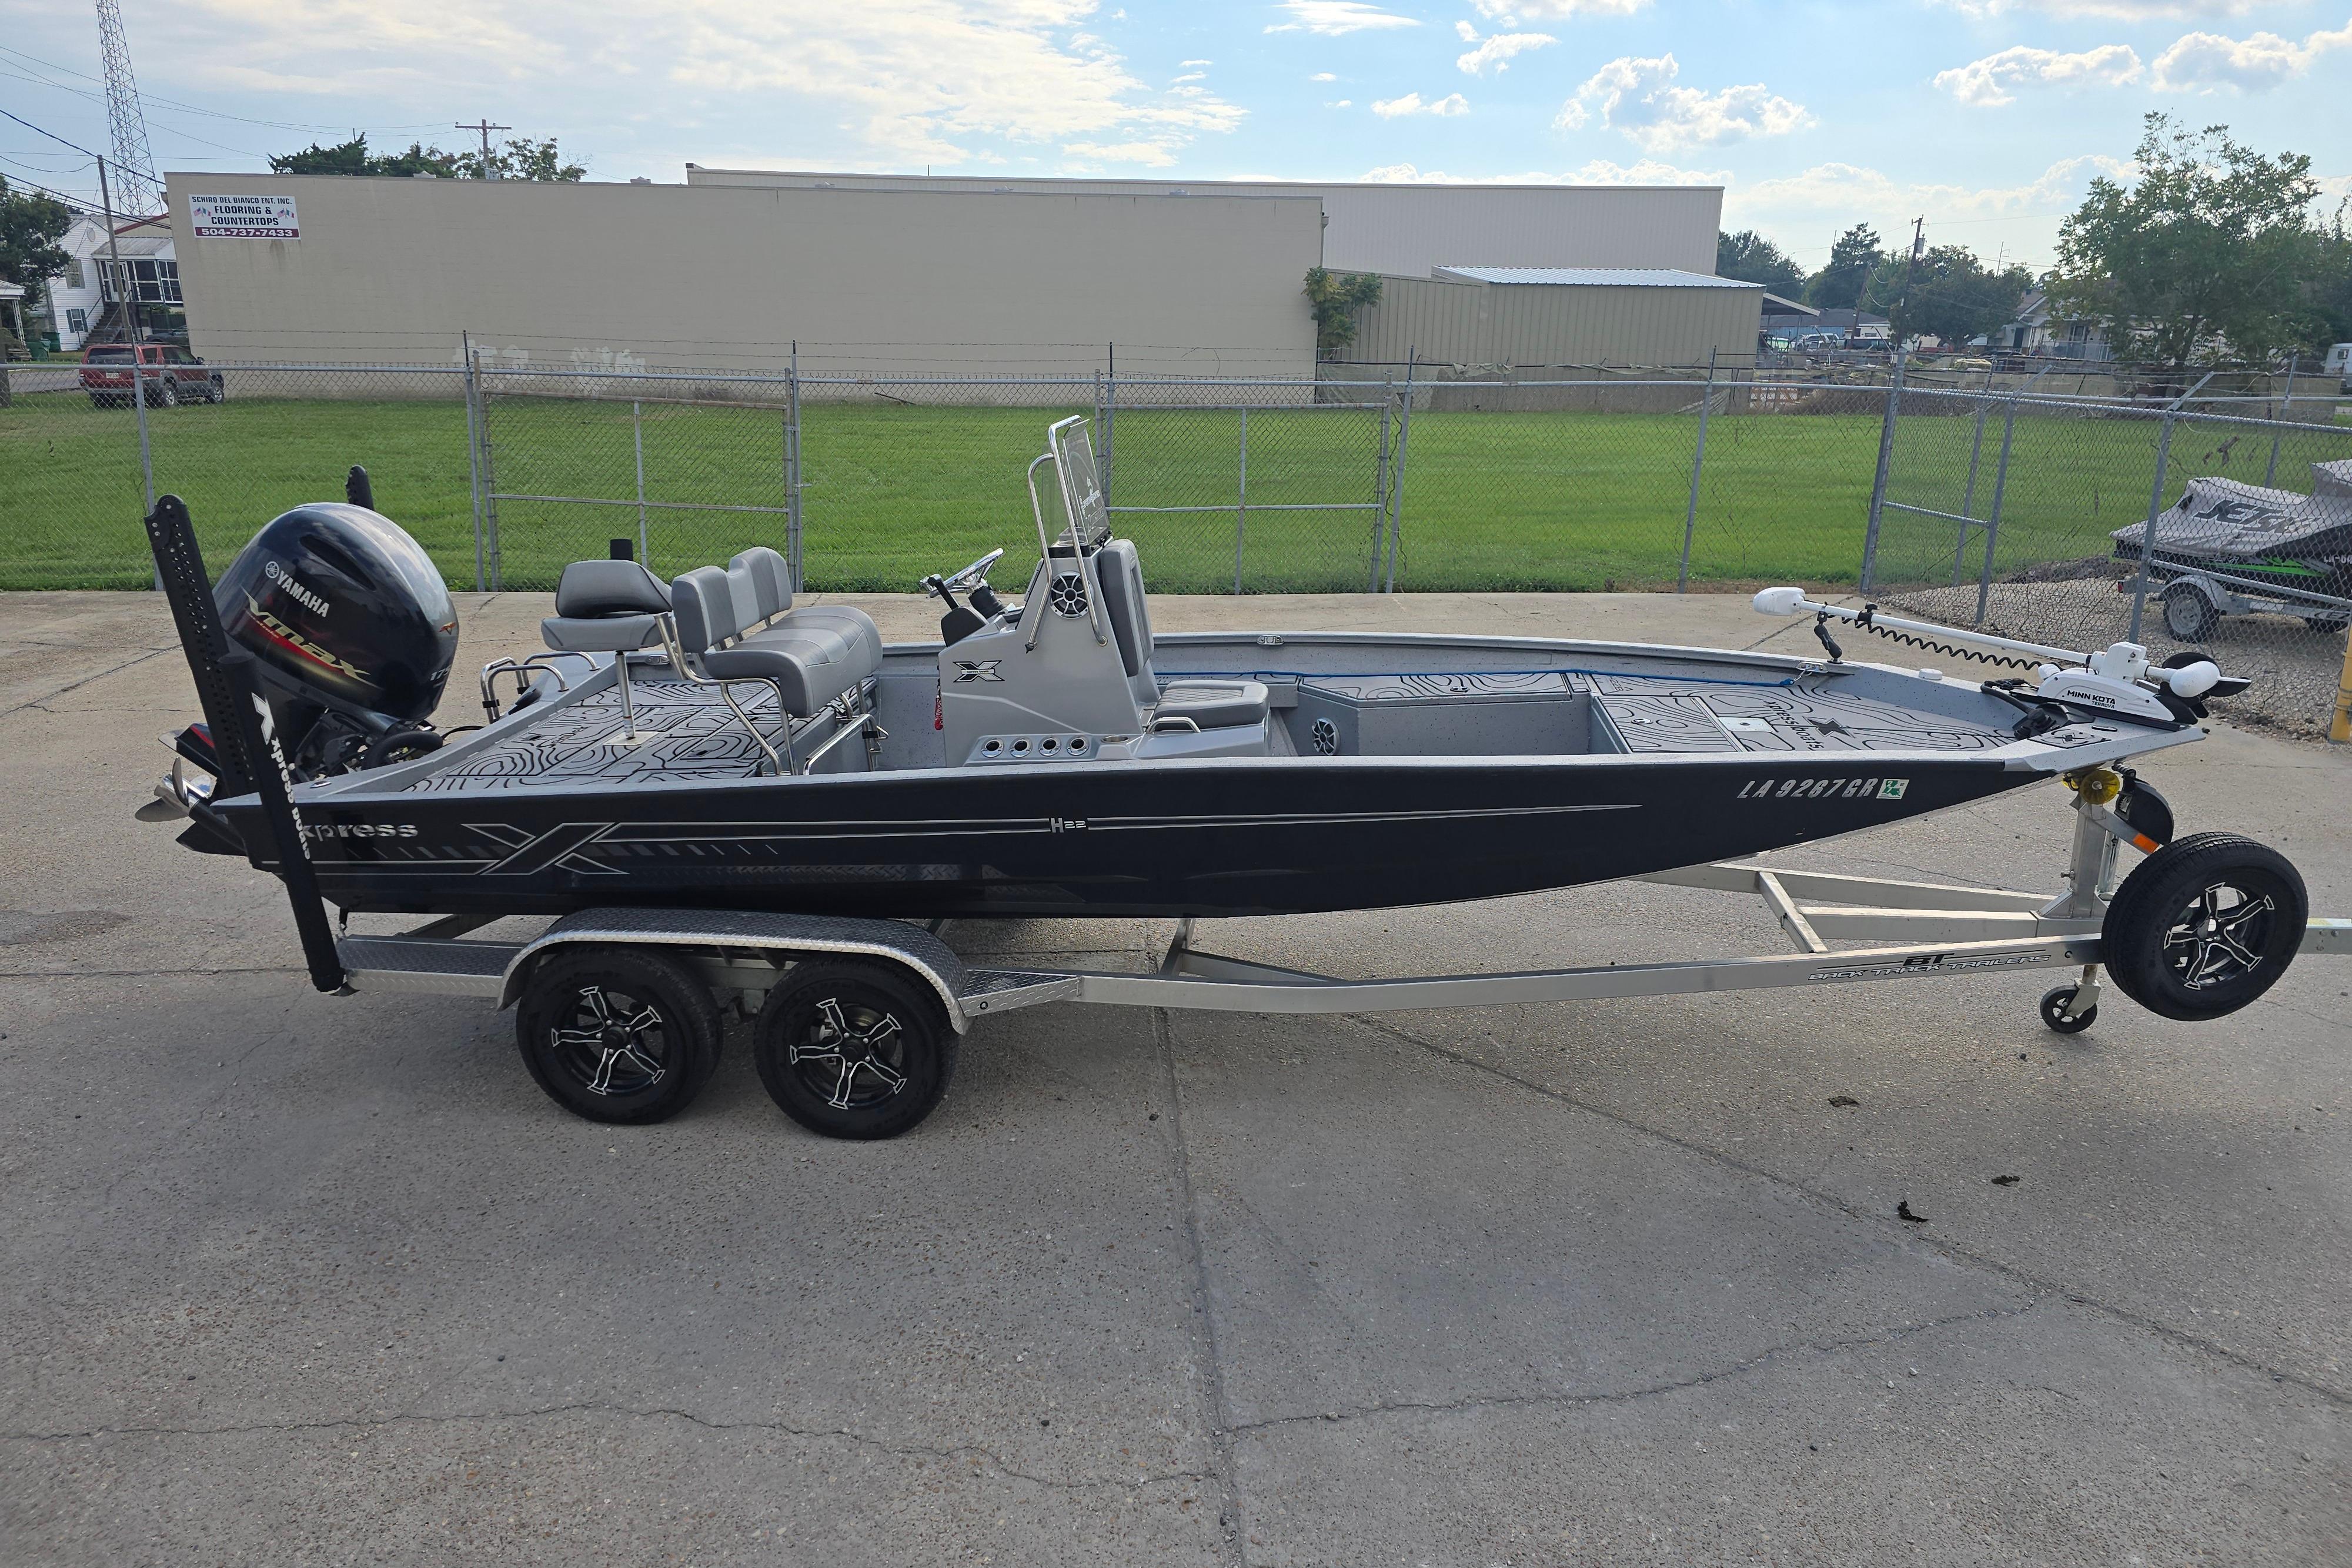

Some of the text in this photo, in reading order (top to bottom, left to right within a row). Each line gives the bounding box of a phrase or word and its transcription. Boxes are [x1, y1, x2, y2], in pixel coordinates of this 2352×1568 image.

[215, 206, 272, 215] FLOORING &
[211, 217, 279, 226] COUNTERTOPS
[202, 228, 293, 236] 504-737-7433
[277, 570, 329, 617] YAMAHA
[2067, 690, 2116, 704] MINN KOTA
[2092, 701, 2114, 709] TERROVA
[1763, 701, 1799, 726] xpress
[1737, 778, 1878, 798] LA 9267 GR
[1050, 817, 1087, 833] H22
[1808, 955, 2052, 981] BACK TRACK TRAILERS
